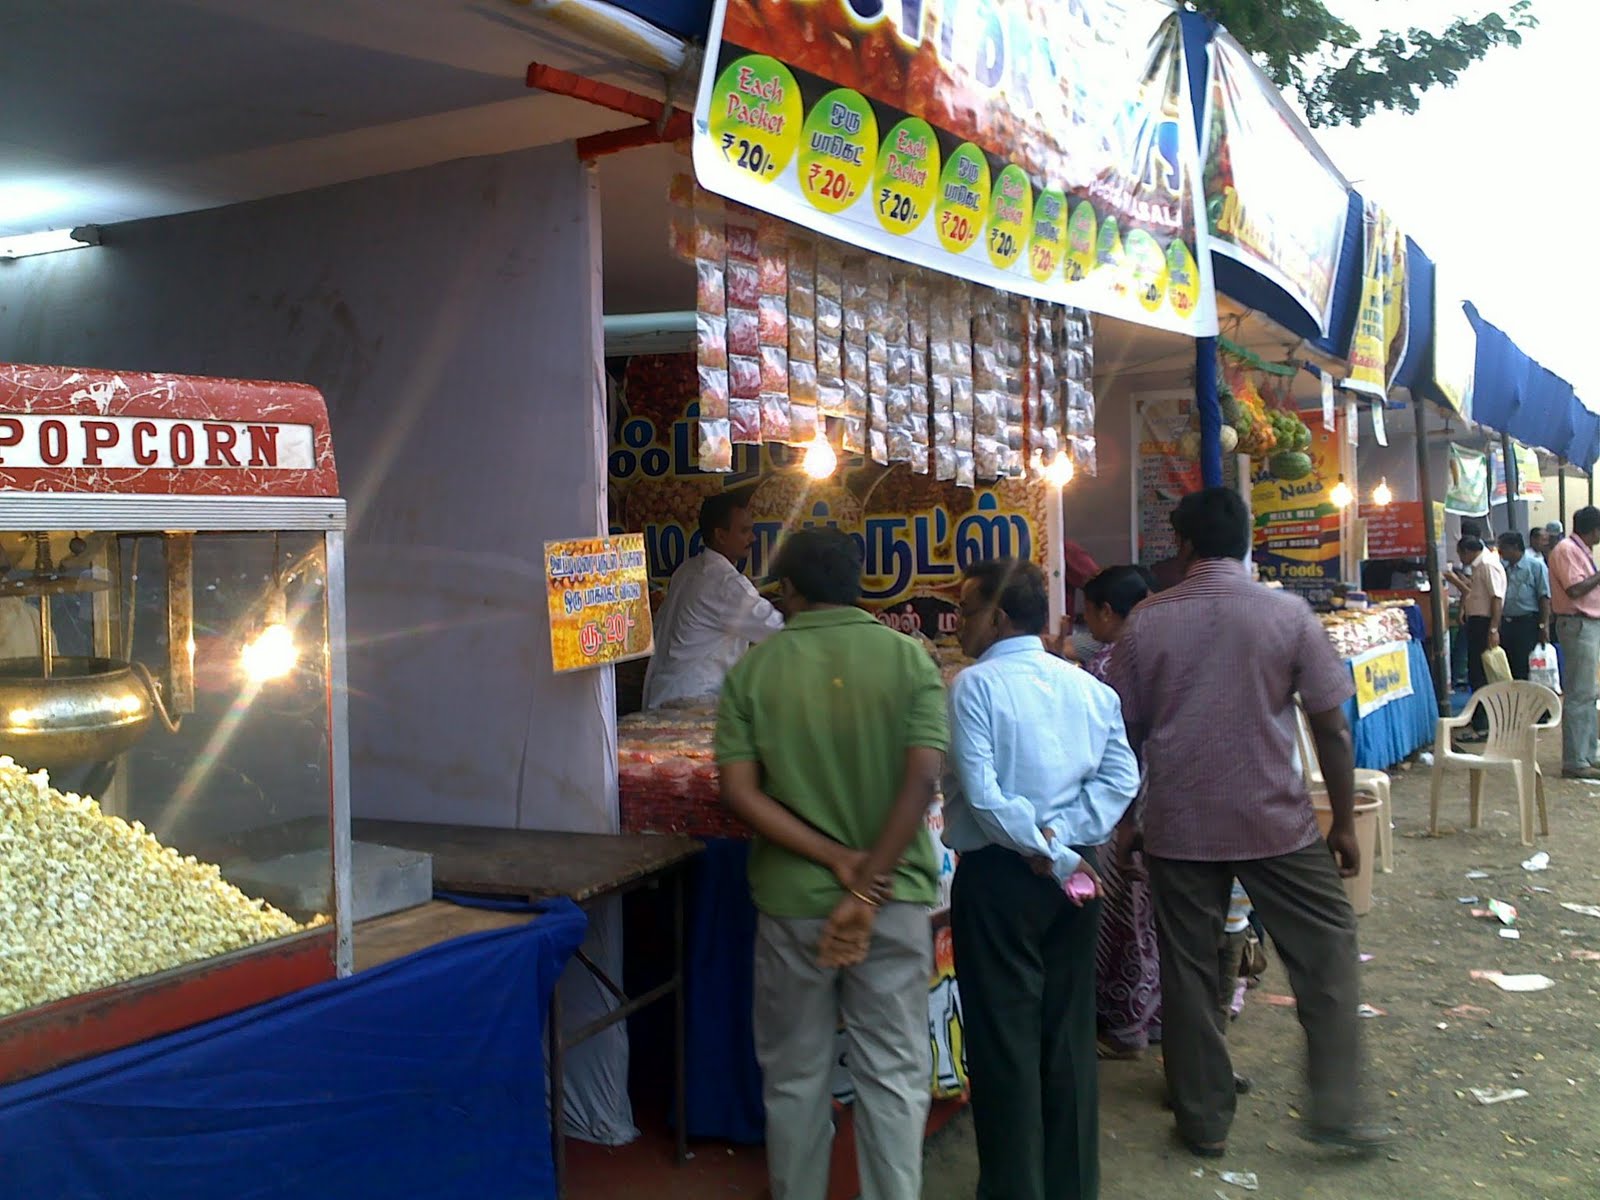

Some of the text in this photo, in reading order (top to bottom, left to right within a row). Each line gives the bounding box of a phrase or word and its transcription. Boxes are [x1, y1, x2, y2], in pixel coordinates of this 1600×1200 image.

[739, 67, 783, 104] Each
[728, 93, 785, 134] Packet
[897, 130, 926, 159] Each
[886, 153, 927, 187] Packet
[0, 417, 279, 467] POPCORN
[1281, 562, 1325, 578] Foods
[565, 591, 582, 614] ஒரு
